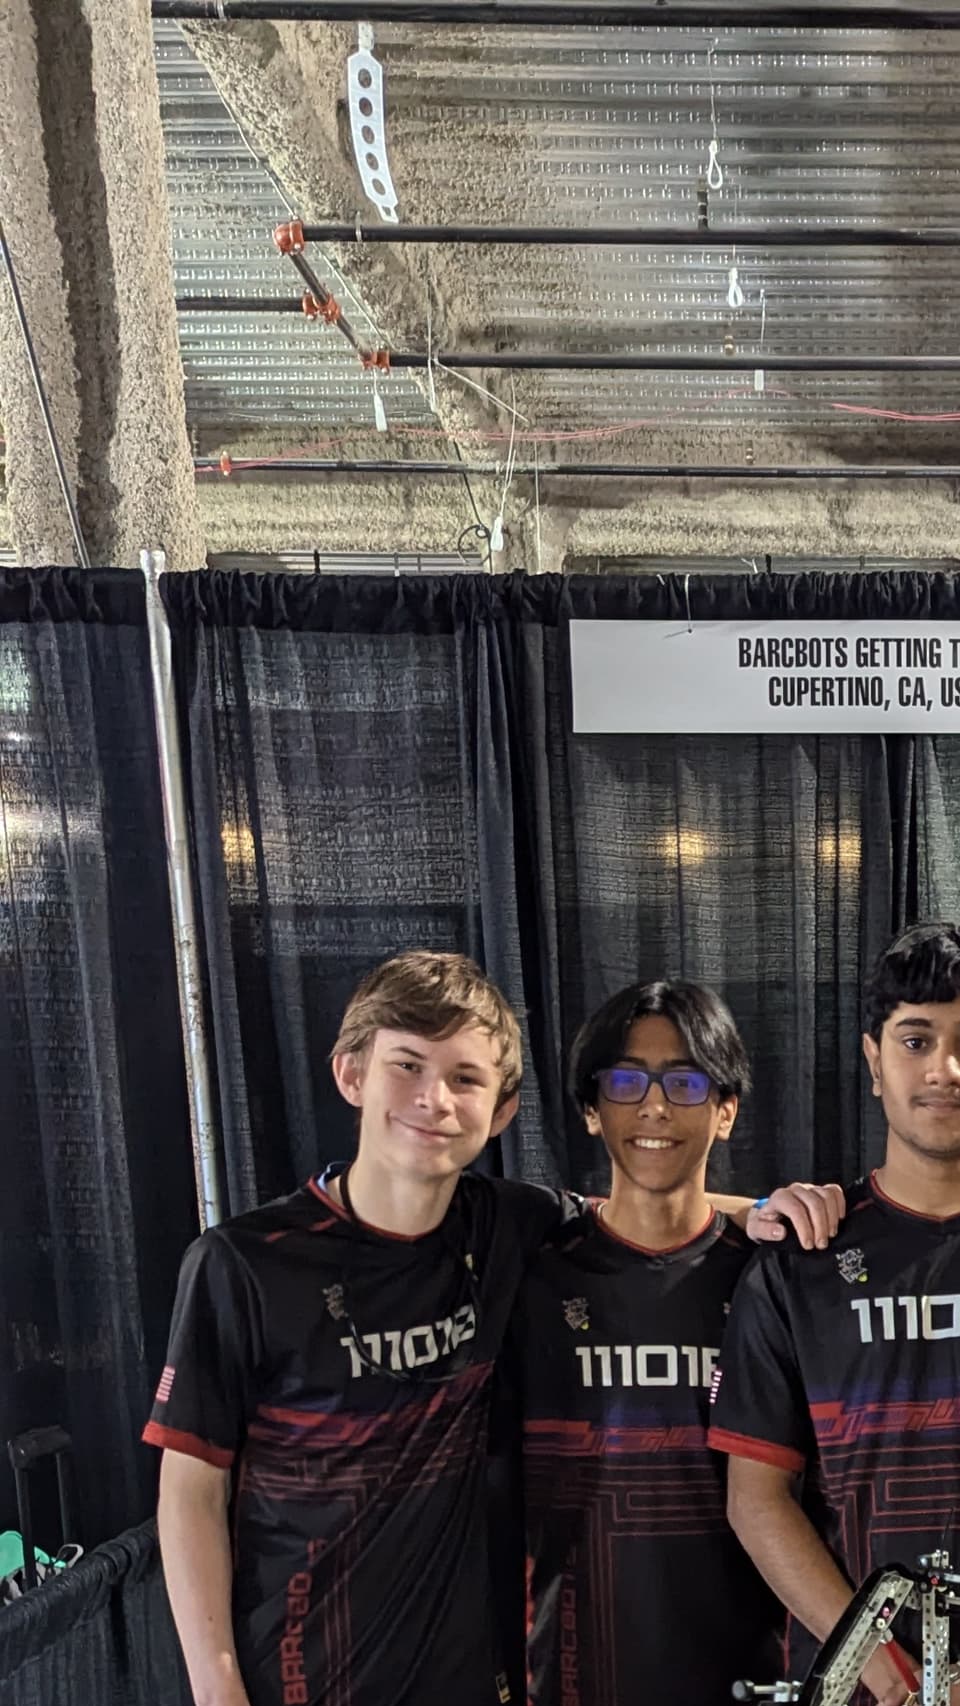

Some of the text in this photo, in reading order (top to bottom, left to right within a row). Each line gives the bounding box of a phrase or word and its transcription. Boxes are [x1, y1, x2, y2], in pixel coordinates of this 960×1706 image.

[738, 637, 848, 669] BARCBOTS
[855, 637, 942, 669] GETTING
[768, 676, 891, 711] CUPERTINO,
[898, 676, 932, 711] CA,
